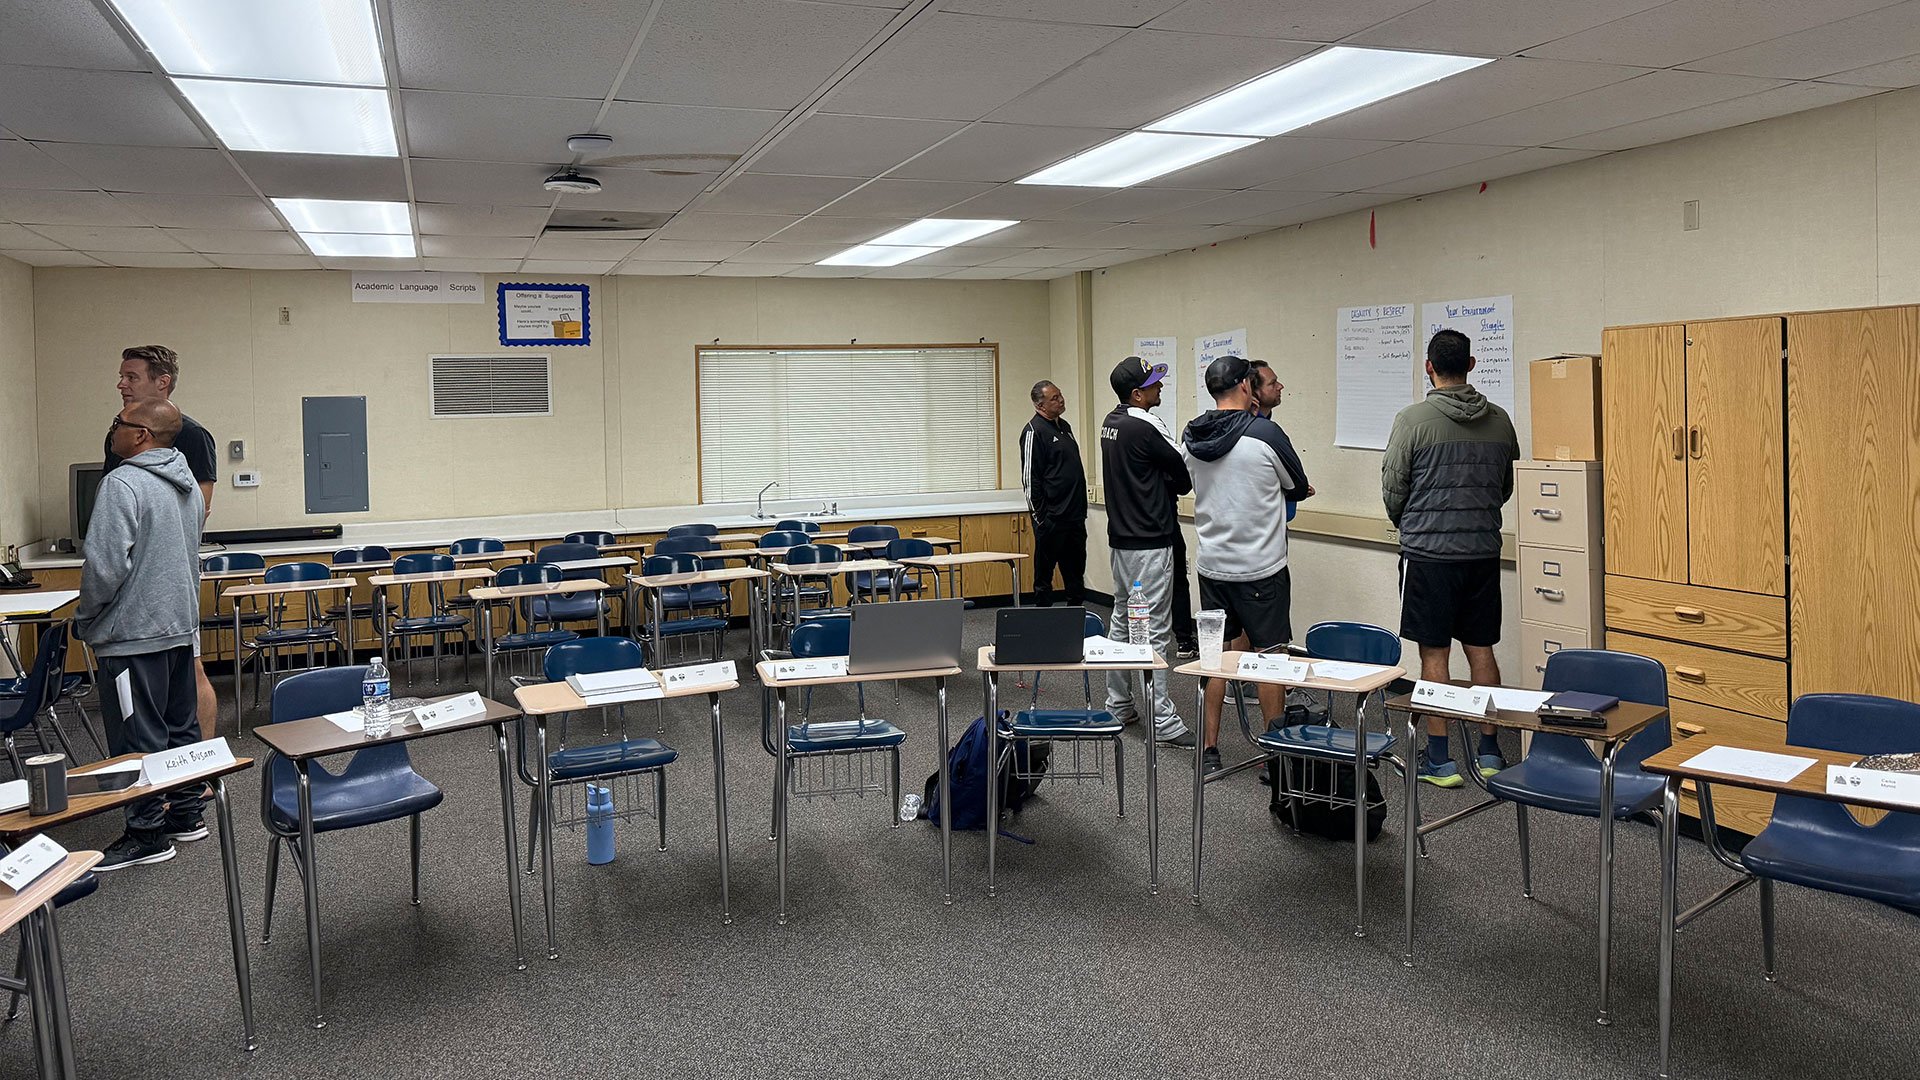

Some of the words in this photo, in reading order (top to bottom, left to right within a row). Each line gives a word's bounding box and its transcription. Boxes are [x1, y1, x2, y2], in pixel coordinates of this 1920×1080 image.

[355, 282, 395, 291] Academic
[399, 283, 439, 292] Language
[449, 283, 477, 292] Scripts
[165, 754, 189, 770] Keith
